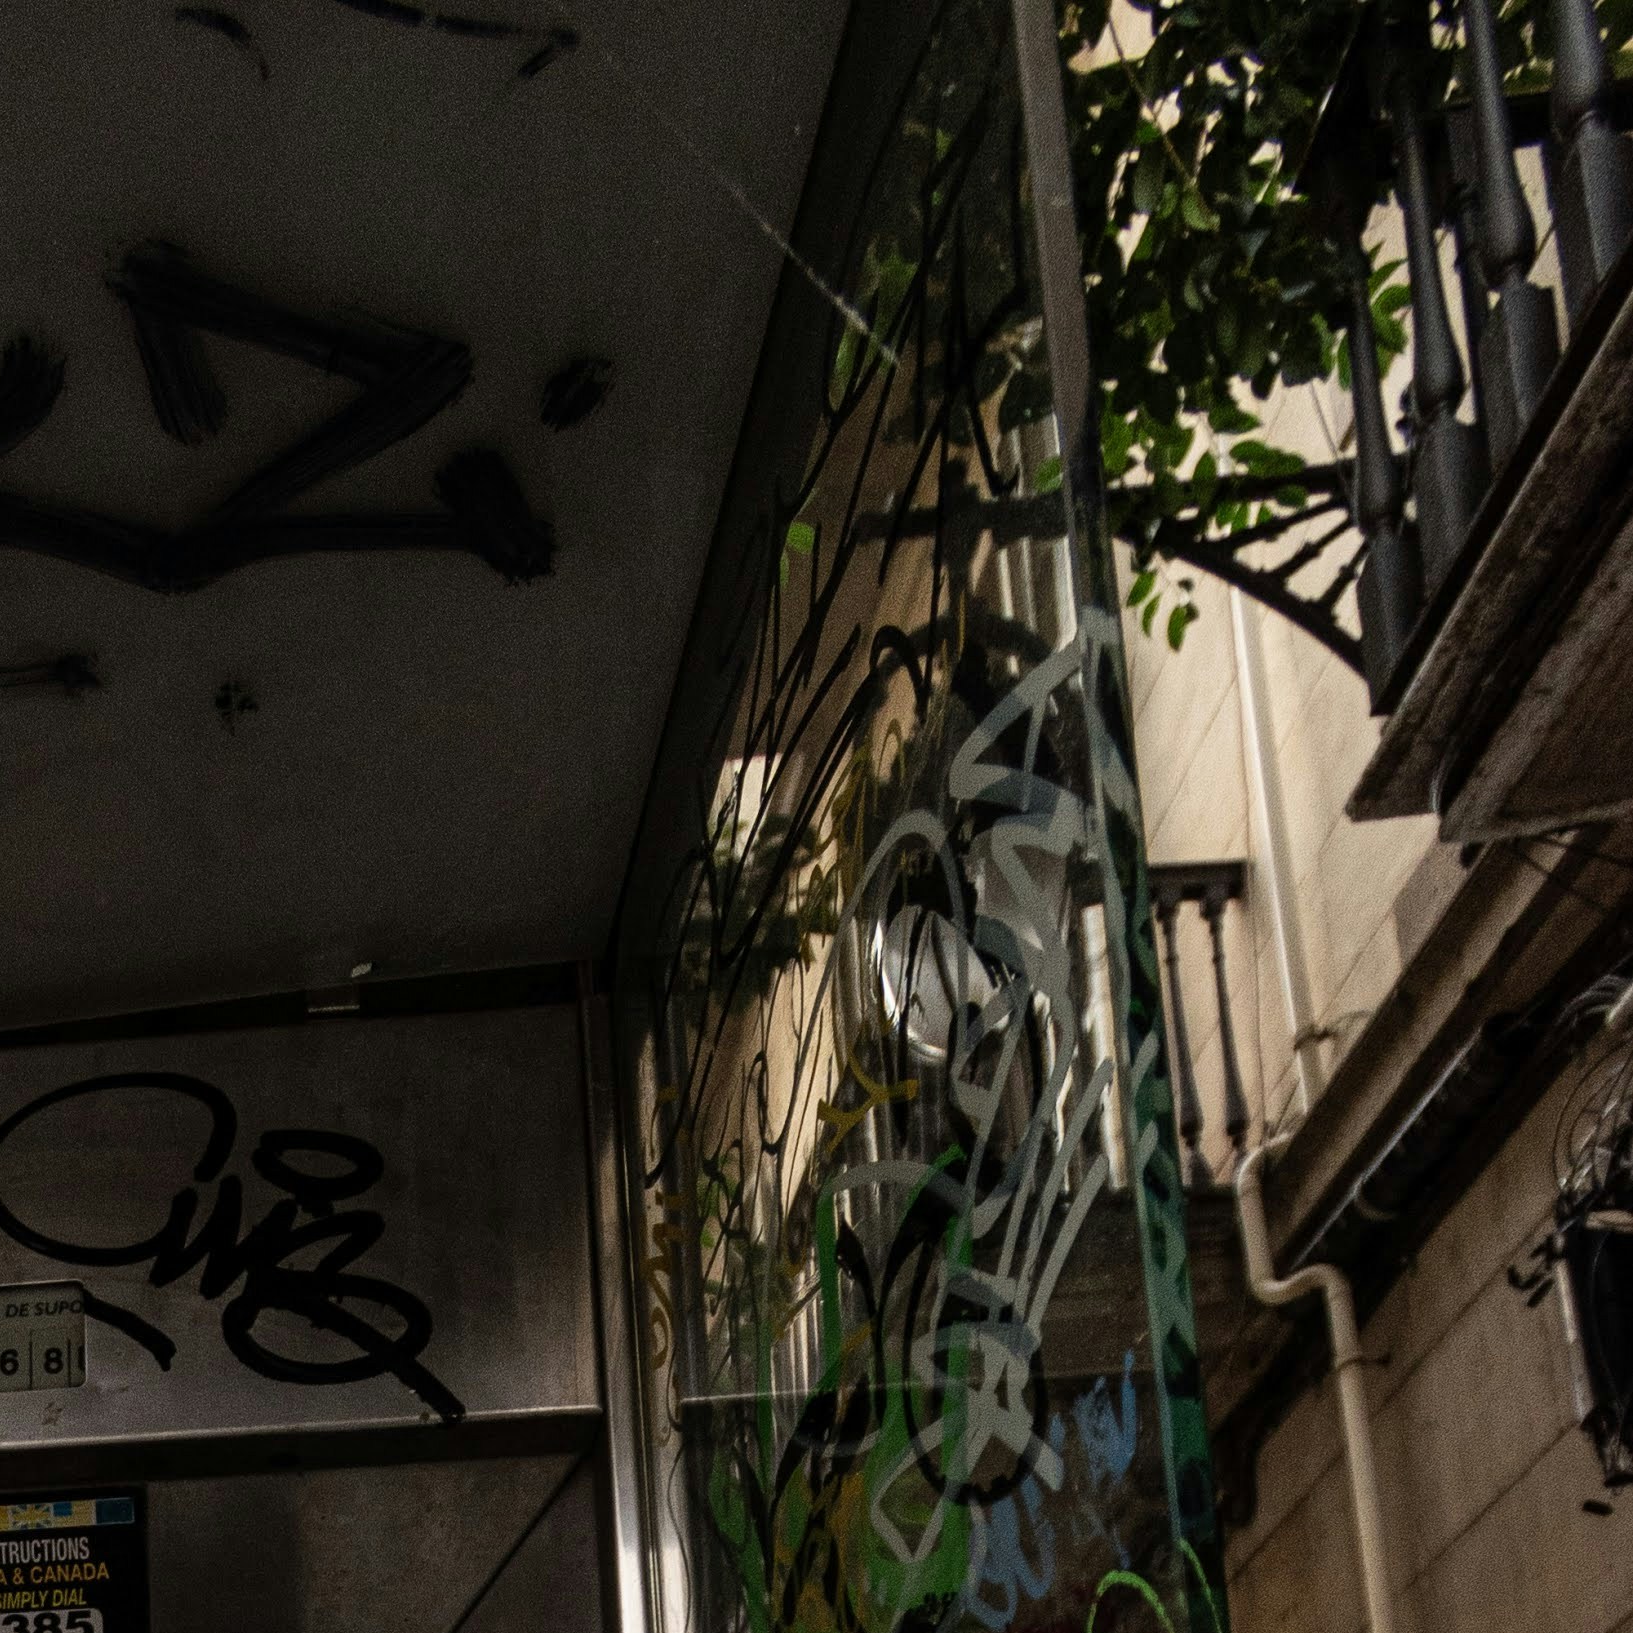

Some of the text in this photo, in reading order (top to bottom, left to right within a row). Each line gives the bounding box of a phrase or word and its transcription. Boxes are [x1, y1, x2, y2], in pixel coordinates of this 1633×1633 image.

[5, 1303, 31, 1318] DE
[13, 1567, 25, 1585] &
[31, 1562, 110, 1584] CANADA
[52, 1587, 87, 1608] DIAL
